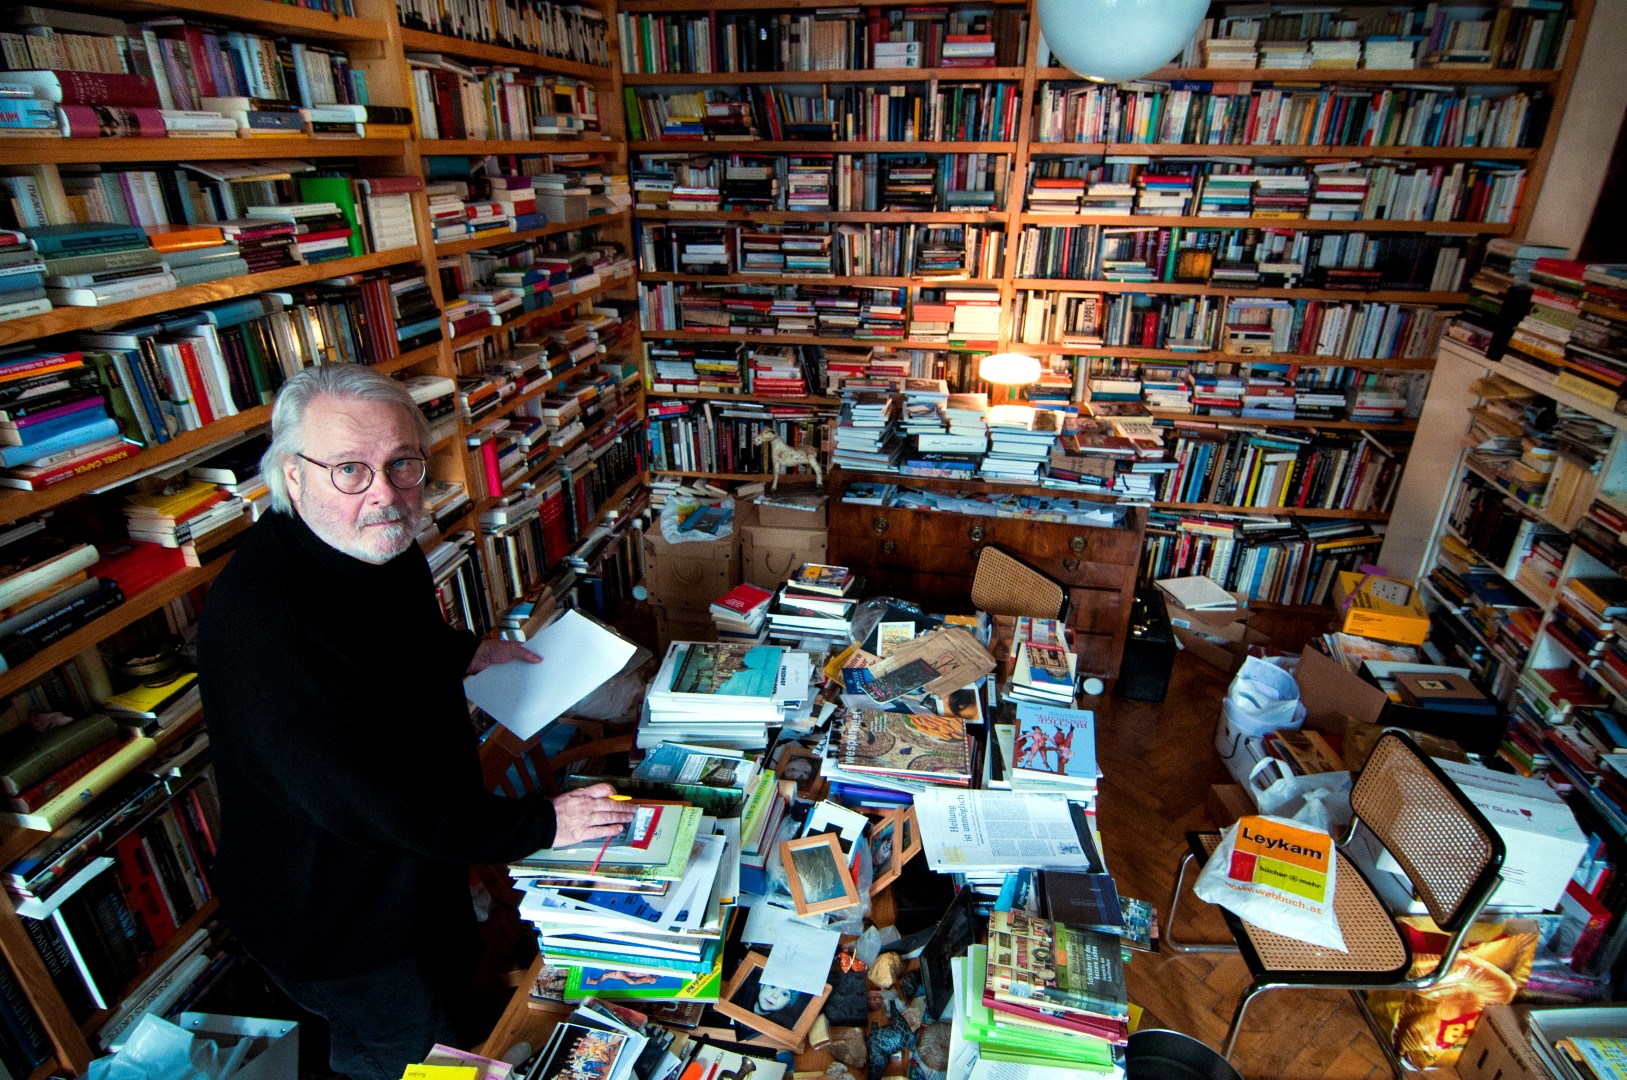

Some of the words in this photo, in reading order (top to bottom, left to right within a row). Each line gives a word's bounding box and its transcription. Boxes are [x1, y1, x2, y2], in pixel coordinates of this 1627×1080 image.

[102, 451, 128, 464] KAREL
[948, 805, 959, 832] Heilung
[958, 795, 970, 831] unmöglich
[1243, 827, 1322, 860] Leykam
[1260, 866, 1288, 879] bücher
[1299, 878, 1322, 889] mehr
[1225, 882, 1323, 915] www.webbuch.at
[50, 937, 73, 967] MALER
[134, 976, 175, 1016] ANDREAS
